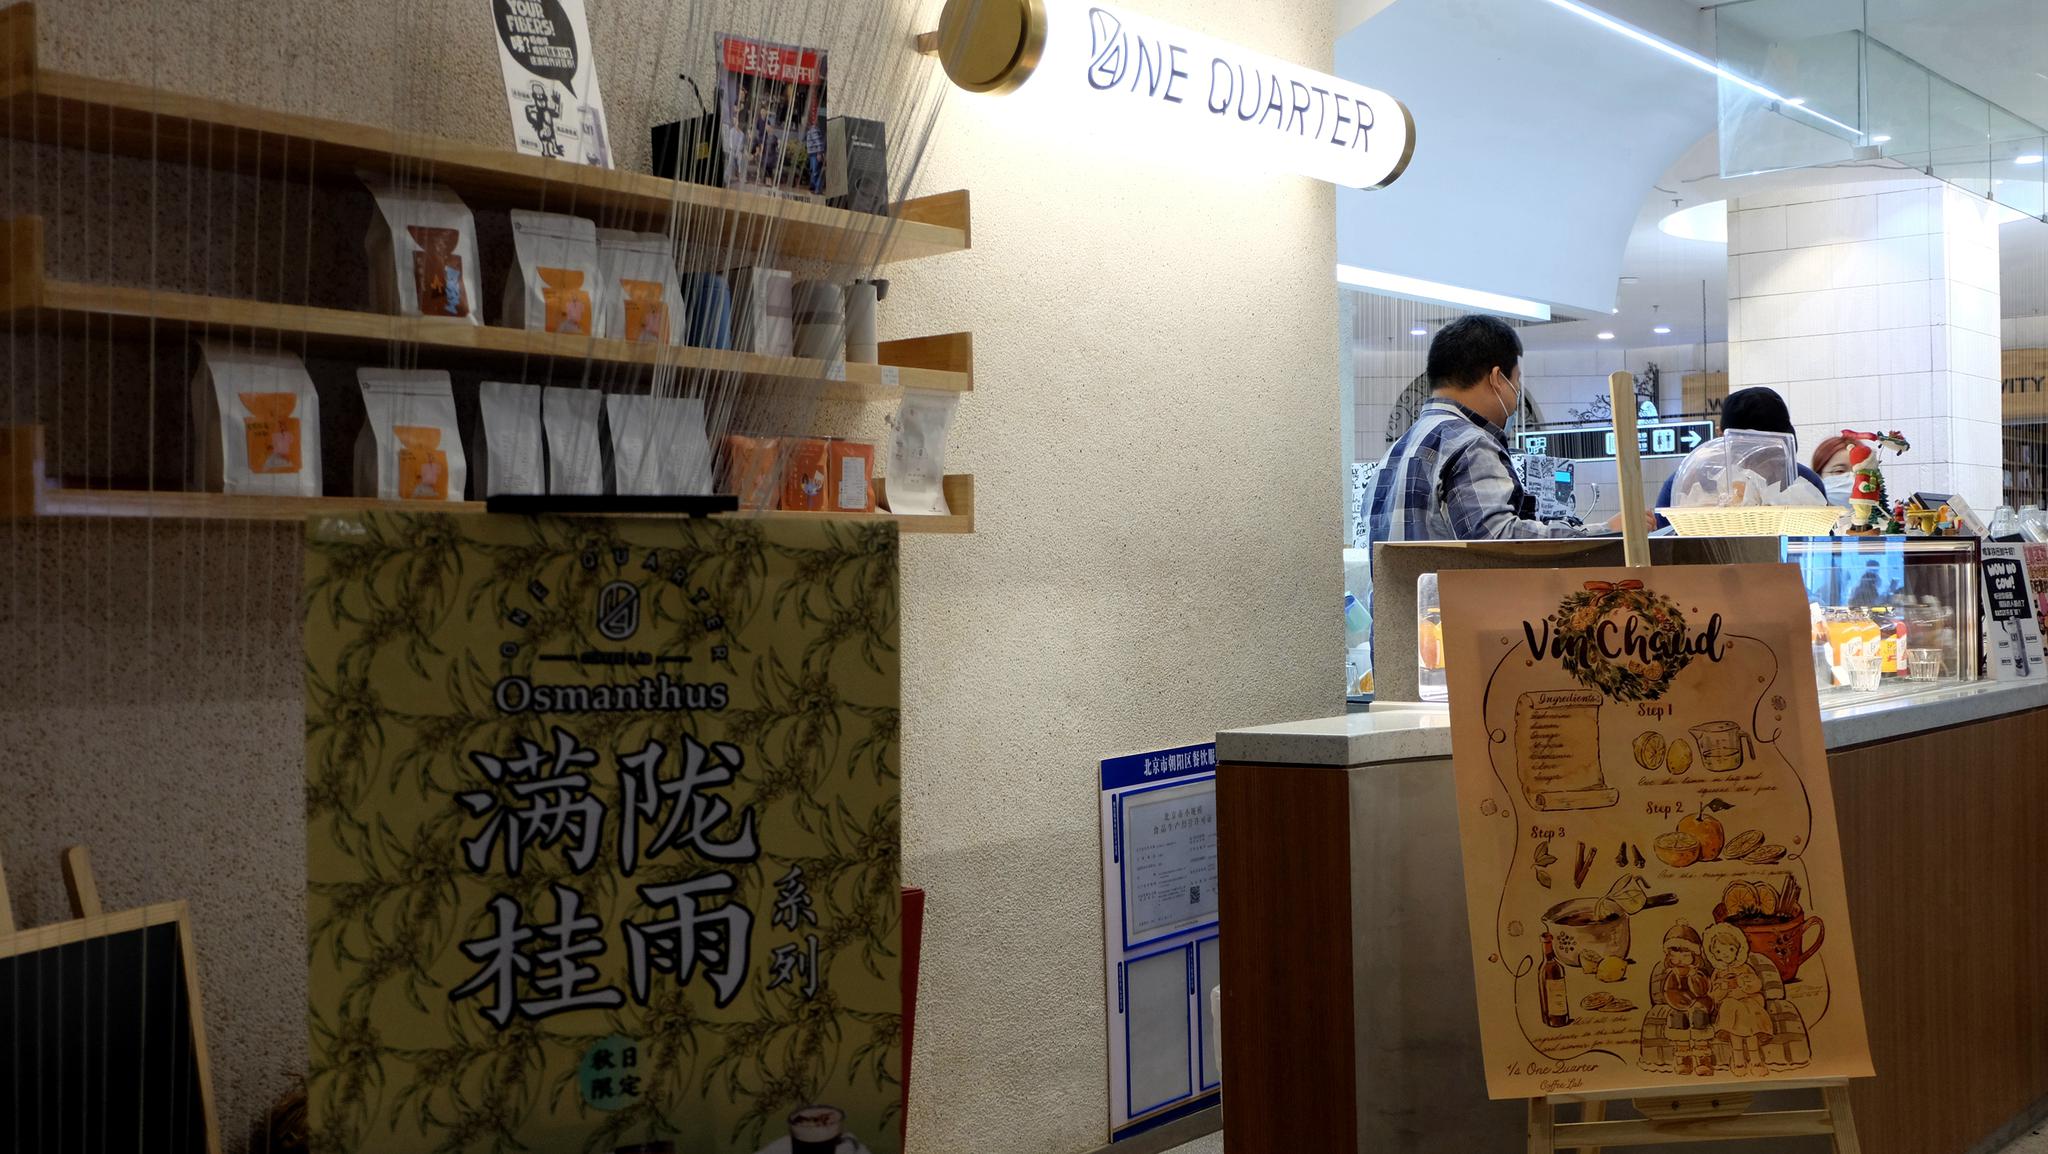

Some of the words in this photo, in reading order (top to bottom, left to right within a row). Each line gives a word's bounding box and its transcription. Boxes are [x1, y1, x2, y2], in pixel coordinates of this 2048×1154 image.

[507, 0, 545, 19] YOUR
[506, 15, 556, 36] FIBERS!
[1208, 57, 1375, 153] QUARTER
[1522, 618, 1591, 665] Vin
[1597, 612, 1725, 664] Chaud
[494, 673, 730, 714] Osmanthus
[1638, 703, 1664, 722] Step
[1668, 703, 1673, 716] 1
[454, 725, 760, 877] 满陇
[1646, 801, 1671, 820] Step
[1676, 801, 1684, 813] 2
[1531, 825, 1554, 841] Step
[1557, 826, 1566, 838] 3
[766, 864, 822, 999] 系列
[448, 871, 755, 1030] 桂雨
[1526, 1061, 1550, 1076] One
[1552, 1059, 1600, 1075] Quarter
